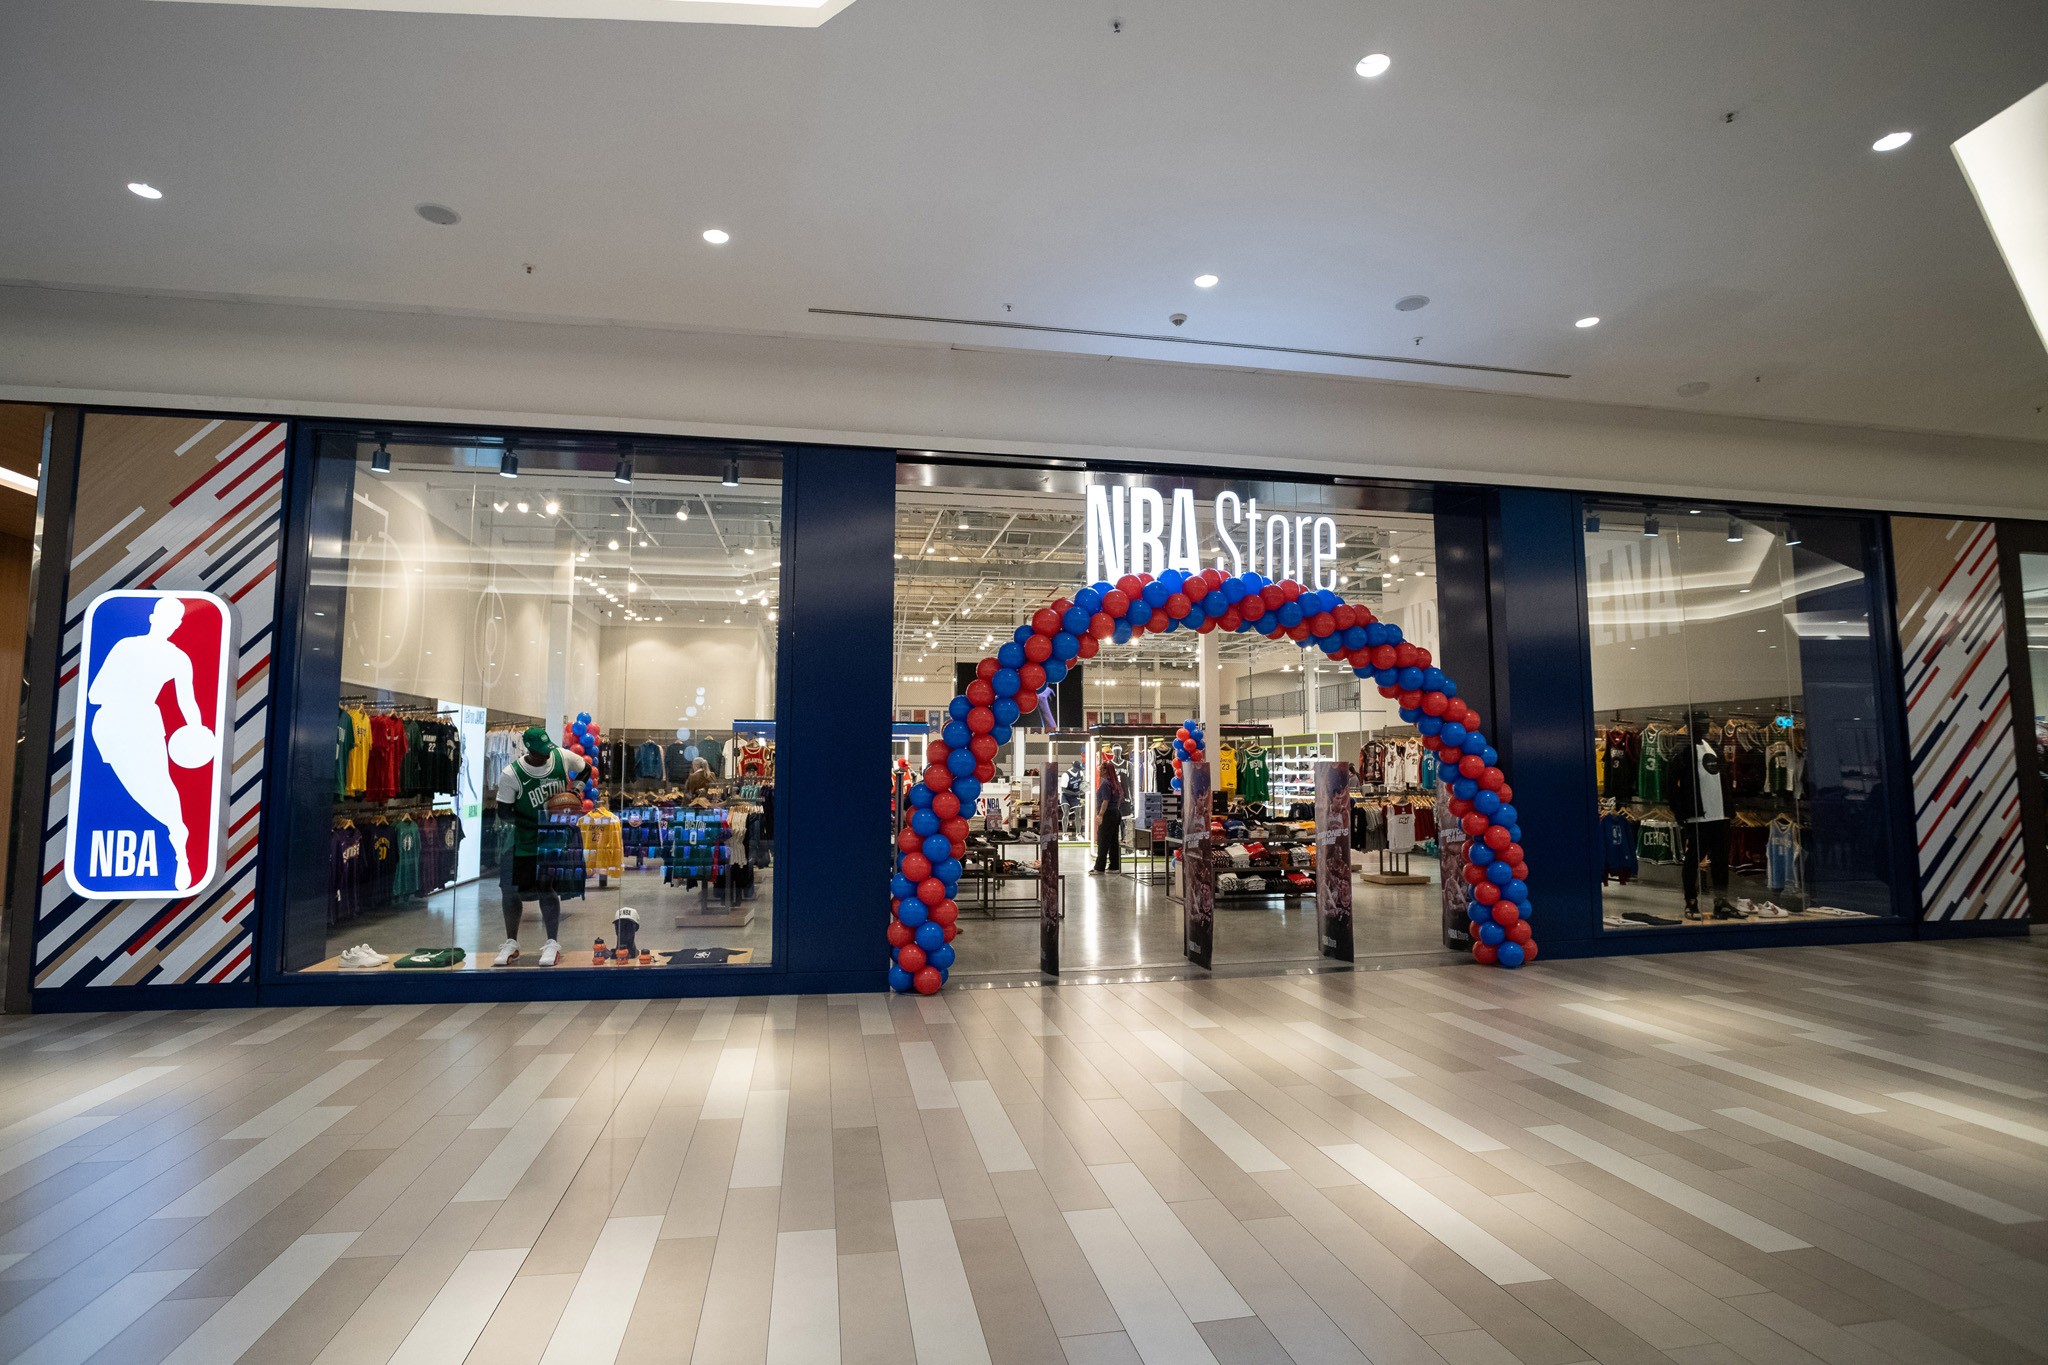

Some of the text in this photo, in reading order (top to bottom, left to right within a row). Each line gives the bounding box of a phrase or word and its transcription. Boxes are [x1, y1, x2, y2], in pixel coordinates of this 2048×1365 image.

[1086, 485, 1337, 592] NBA Store
[428, 743, 437, 752] 22
[744, 757, 763, 765] ATLANTA
[1646, 757, 1656, 771] 3
[528, 779, 566, 808] BOSTON
[987, 797, 999, 809] NBA
[685, 820, 706, 832] BOSTON
[690, 831, 697, 845] 0
[89, 830, 158, 877] NBA
